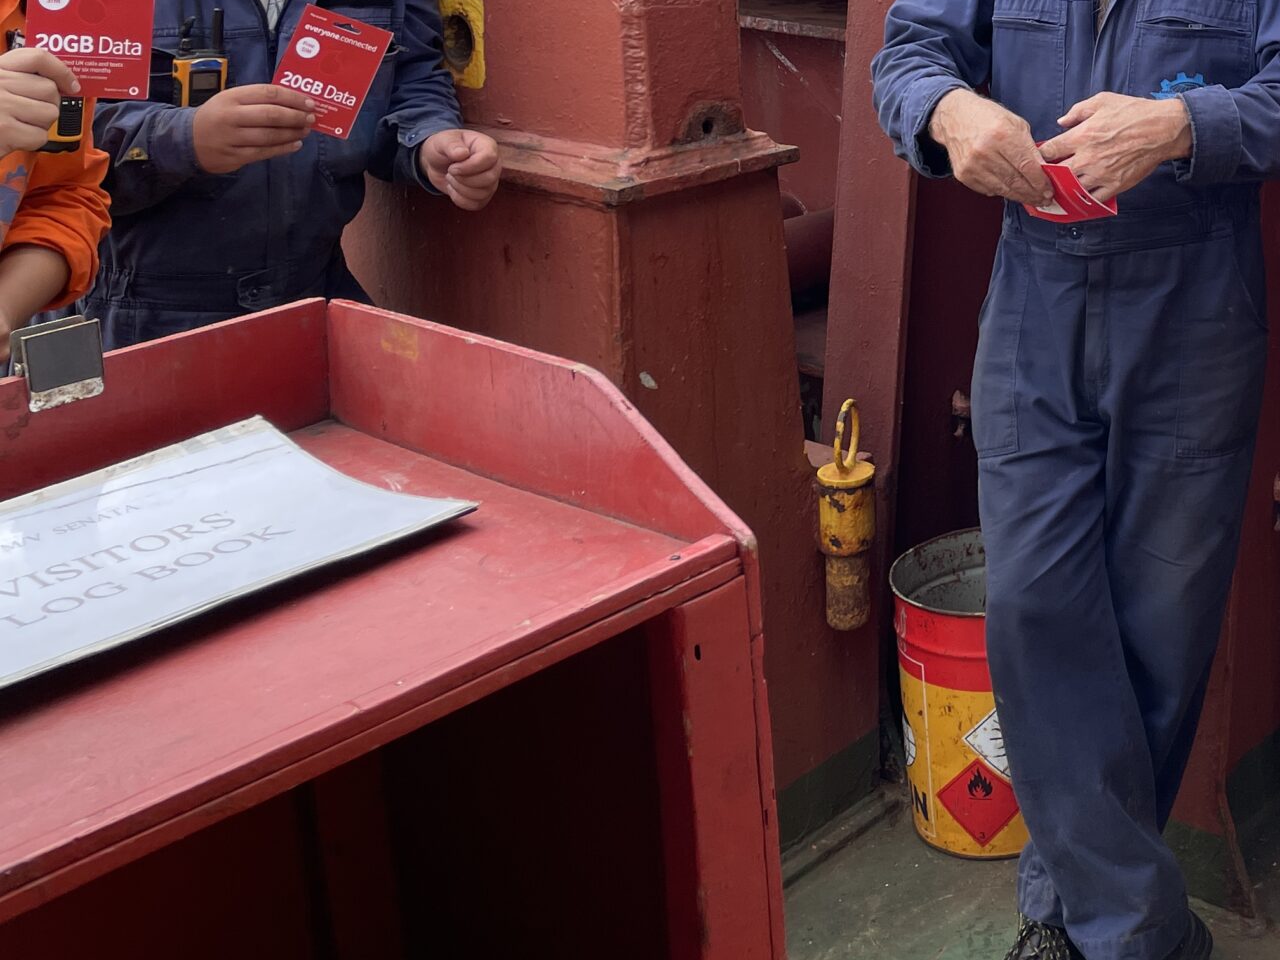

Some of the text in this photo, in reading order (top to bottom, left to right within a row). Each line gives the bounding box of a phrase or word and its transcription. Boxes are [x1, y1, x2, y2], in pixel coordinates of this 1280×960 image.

[35, 33, 142, 56] 20GB Data
[304, 23, 378, 53] everyone.connected
[280, 71, 357, 107] 20GB Data
[52, 503, 141, 535] SENATA
[0, 525, 297, 629] LOG BOOK
